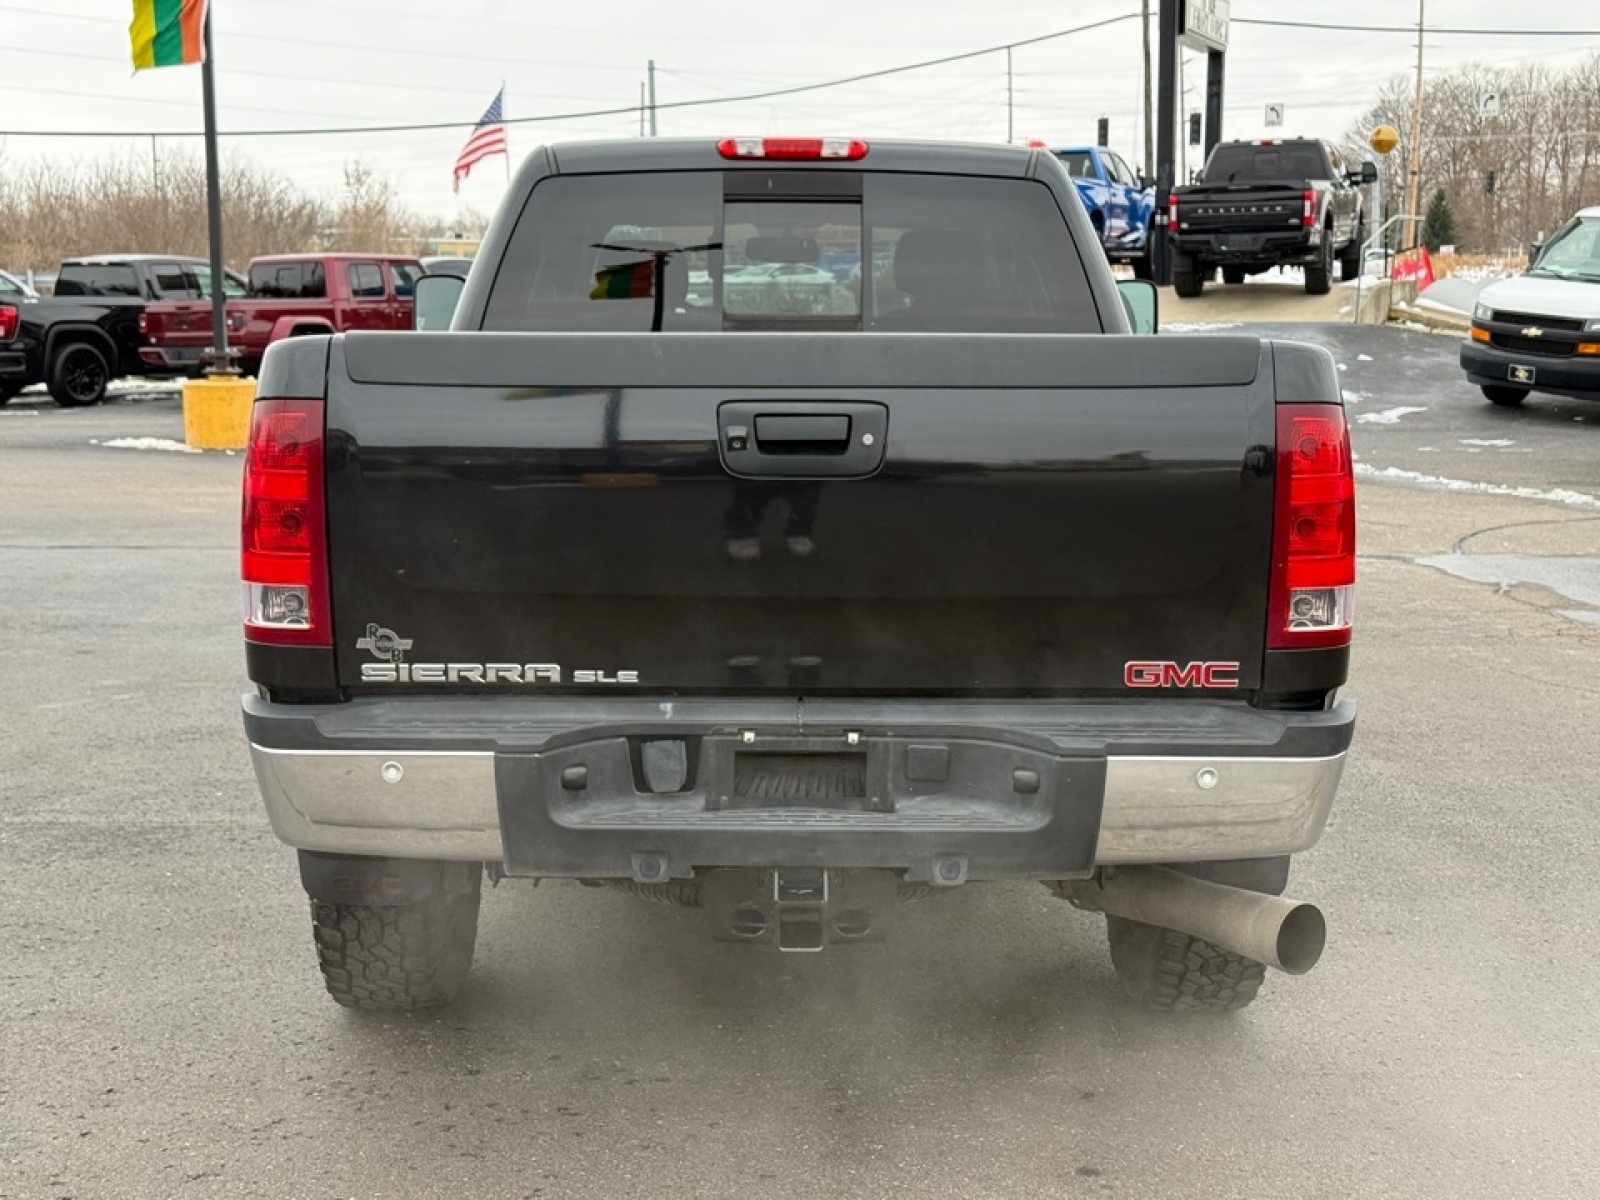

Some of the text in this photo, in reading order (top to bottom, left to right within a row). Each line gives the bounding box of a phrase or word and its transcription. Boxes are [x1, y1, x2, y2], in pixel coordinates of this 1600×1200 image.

[361, 662, 640, 684] SIERRA SLE
[1124, 661, 1240, 688] GMC
